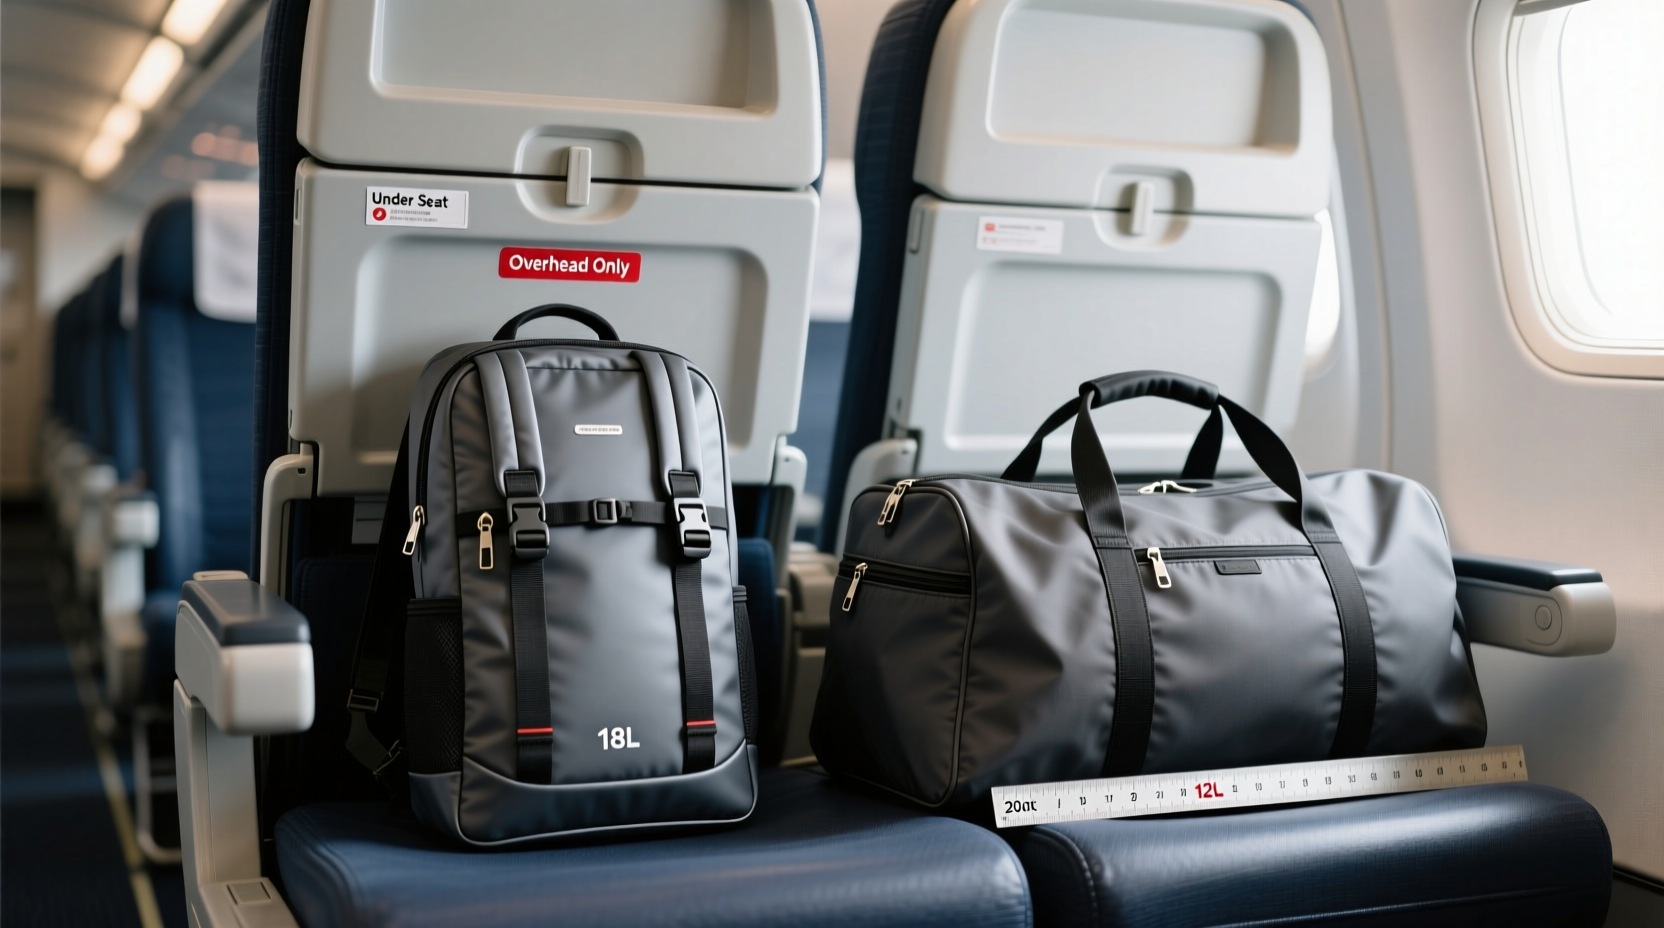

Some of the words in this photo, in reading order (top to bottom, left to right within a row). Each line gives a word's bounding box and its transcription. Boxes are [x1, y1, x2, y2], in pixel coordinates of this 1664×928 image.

[372, 191, 414, 206] Under
[417, 194, 449, 208] Seat
[509, 254, 588, 273] Overhead
[592, 257, 630, 279] Only
[597, 726, 640, 750] 18L
[1195, 781, 1224, 799] 12L
